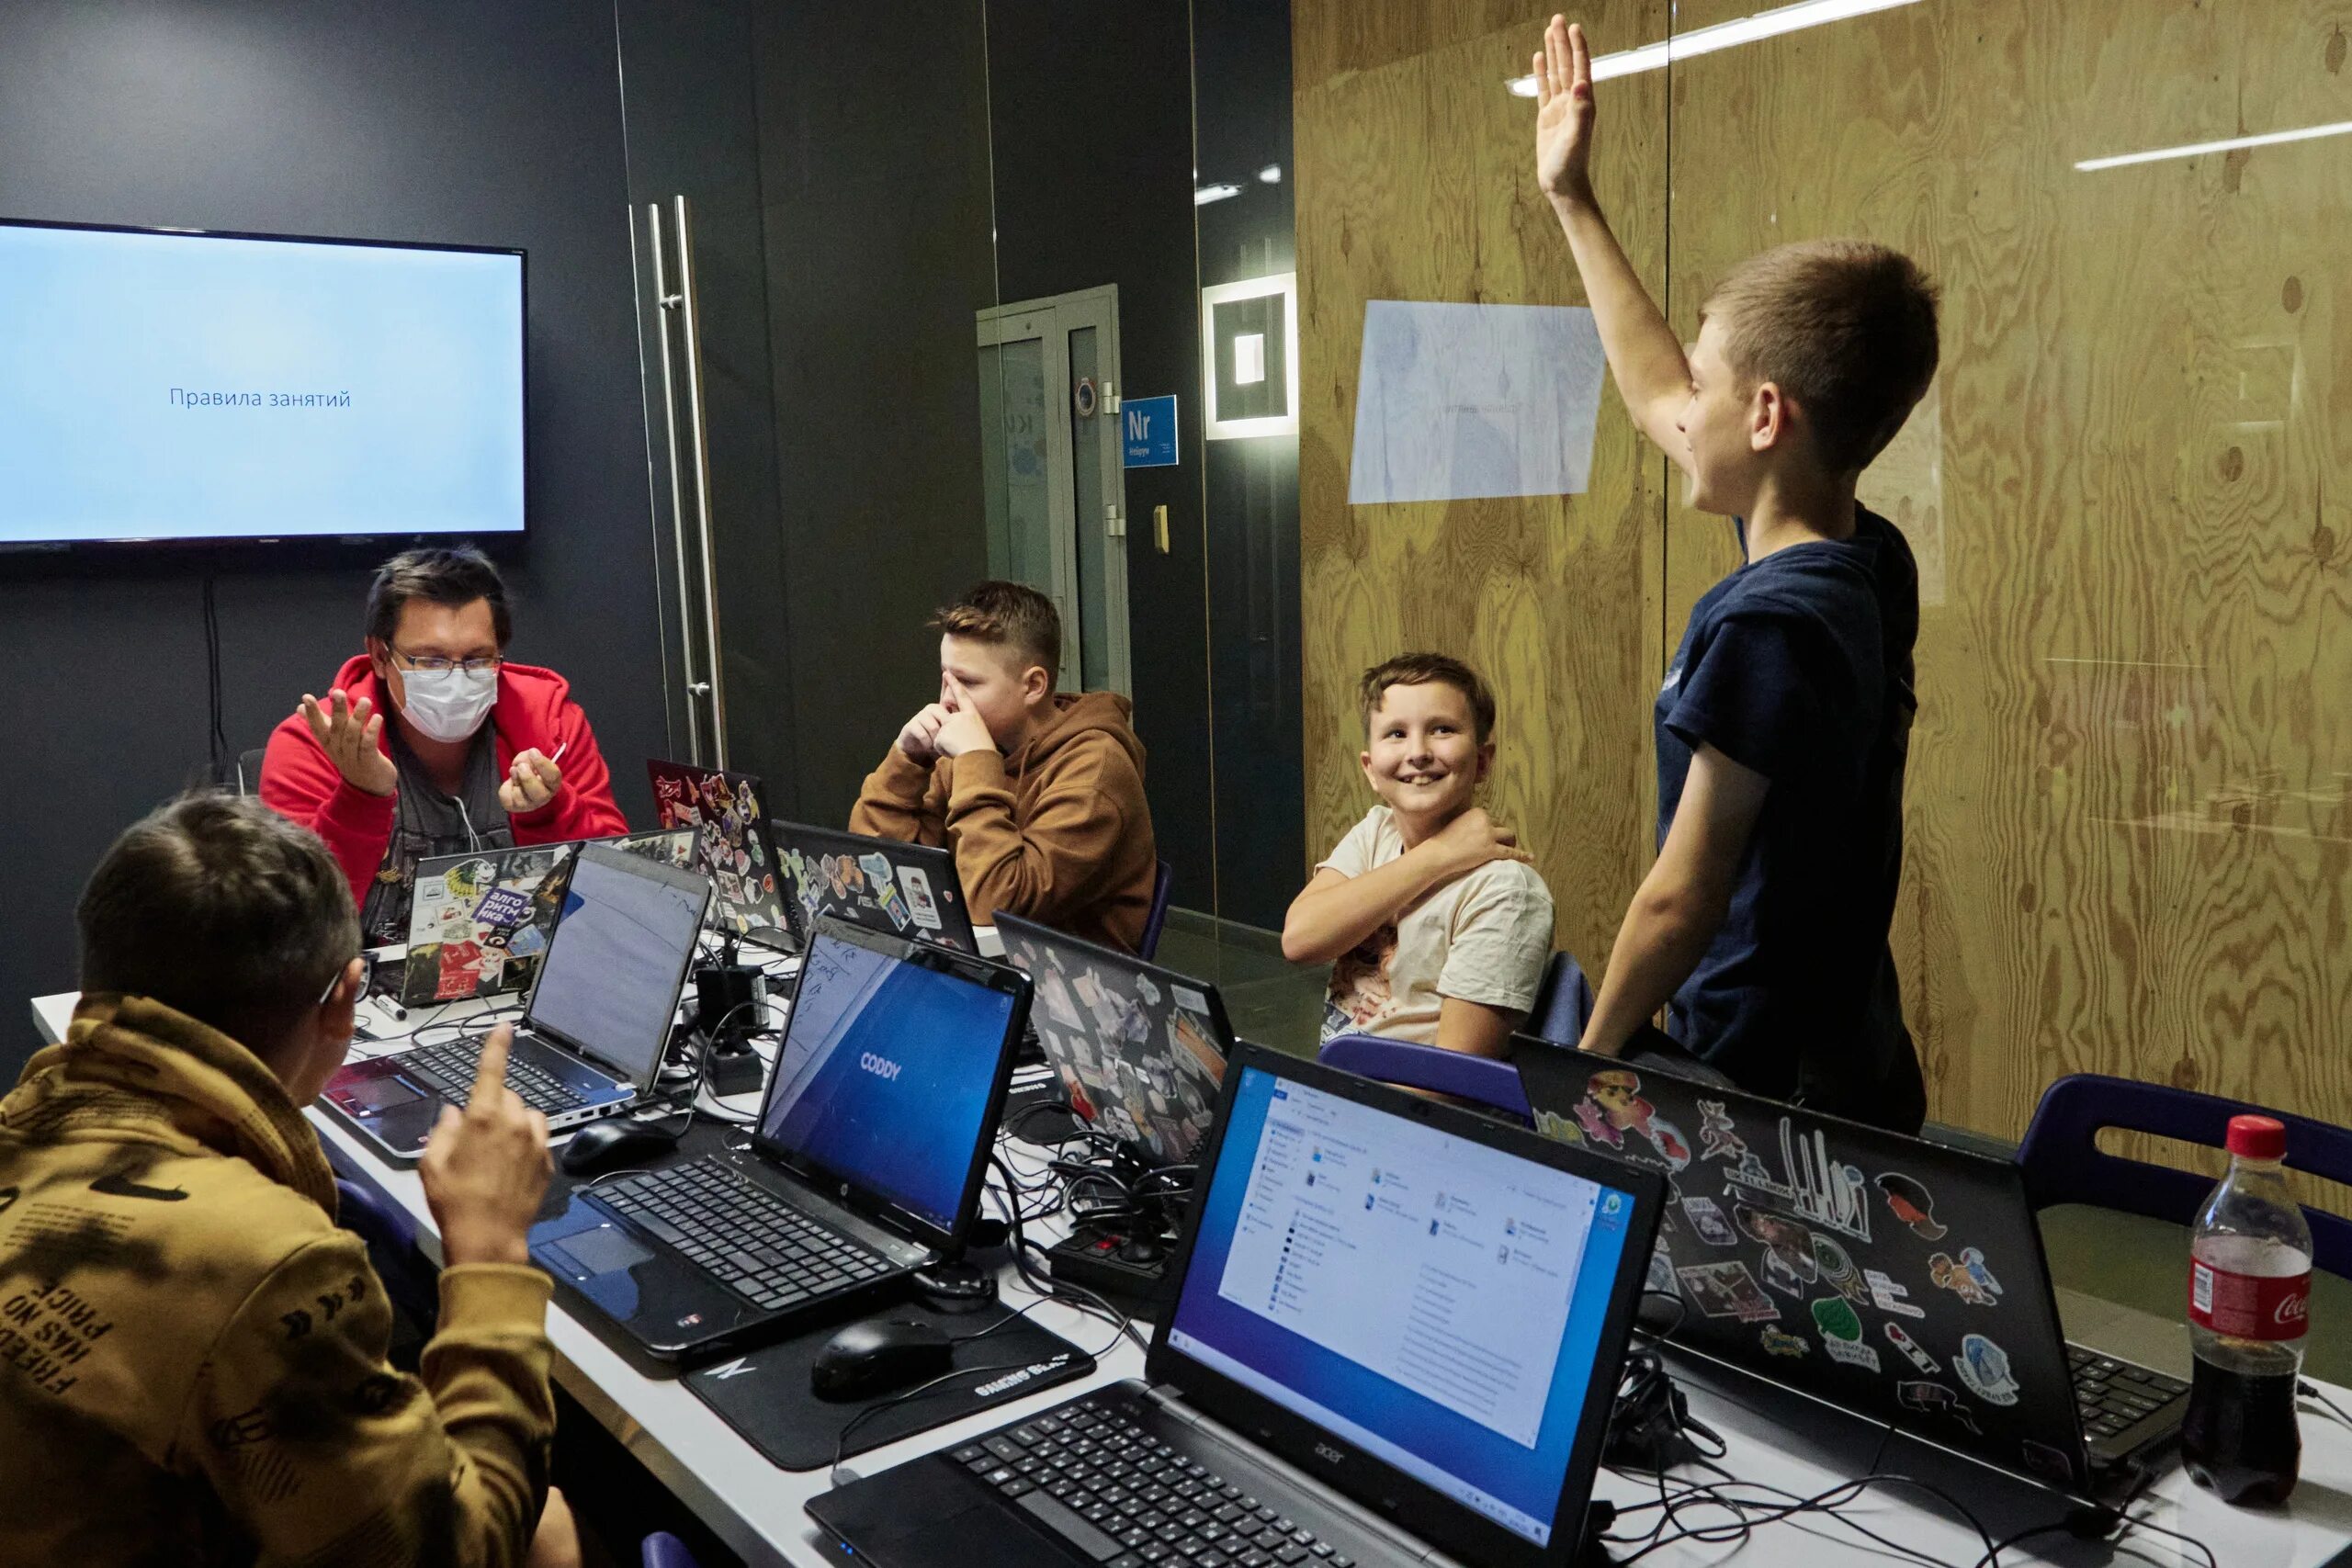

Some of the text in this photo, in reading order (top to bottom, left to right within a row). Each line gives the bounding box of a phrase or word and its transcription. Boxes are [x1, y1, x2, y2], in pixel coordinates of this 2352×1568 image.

[170, 388, 351, 410] Правила занятий
[1128, 410, 1150, 441] Nr
[481, 900, 521, 917] ритм
[489, 891, 523, 908] алго
[861, 1052, 901, 1081] CODDY
[3, 1294, 45, 1328] NO
[975, 1369, 1030, 1396] GAMING
[1314, 1442, 1345, 1464] acer
